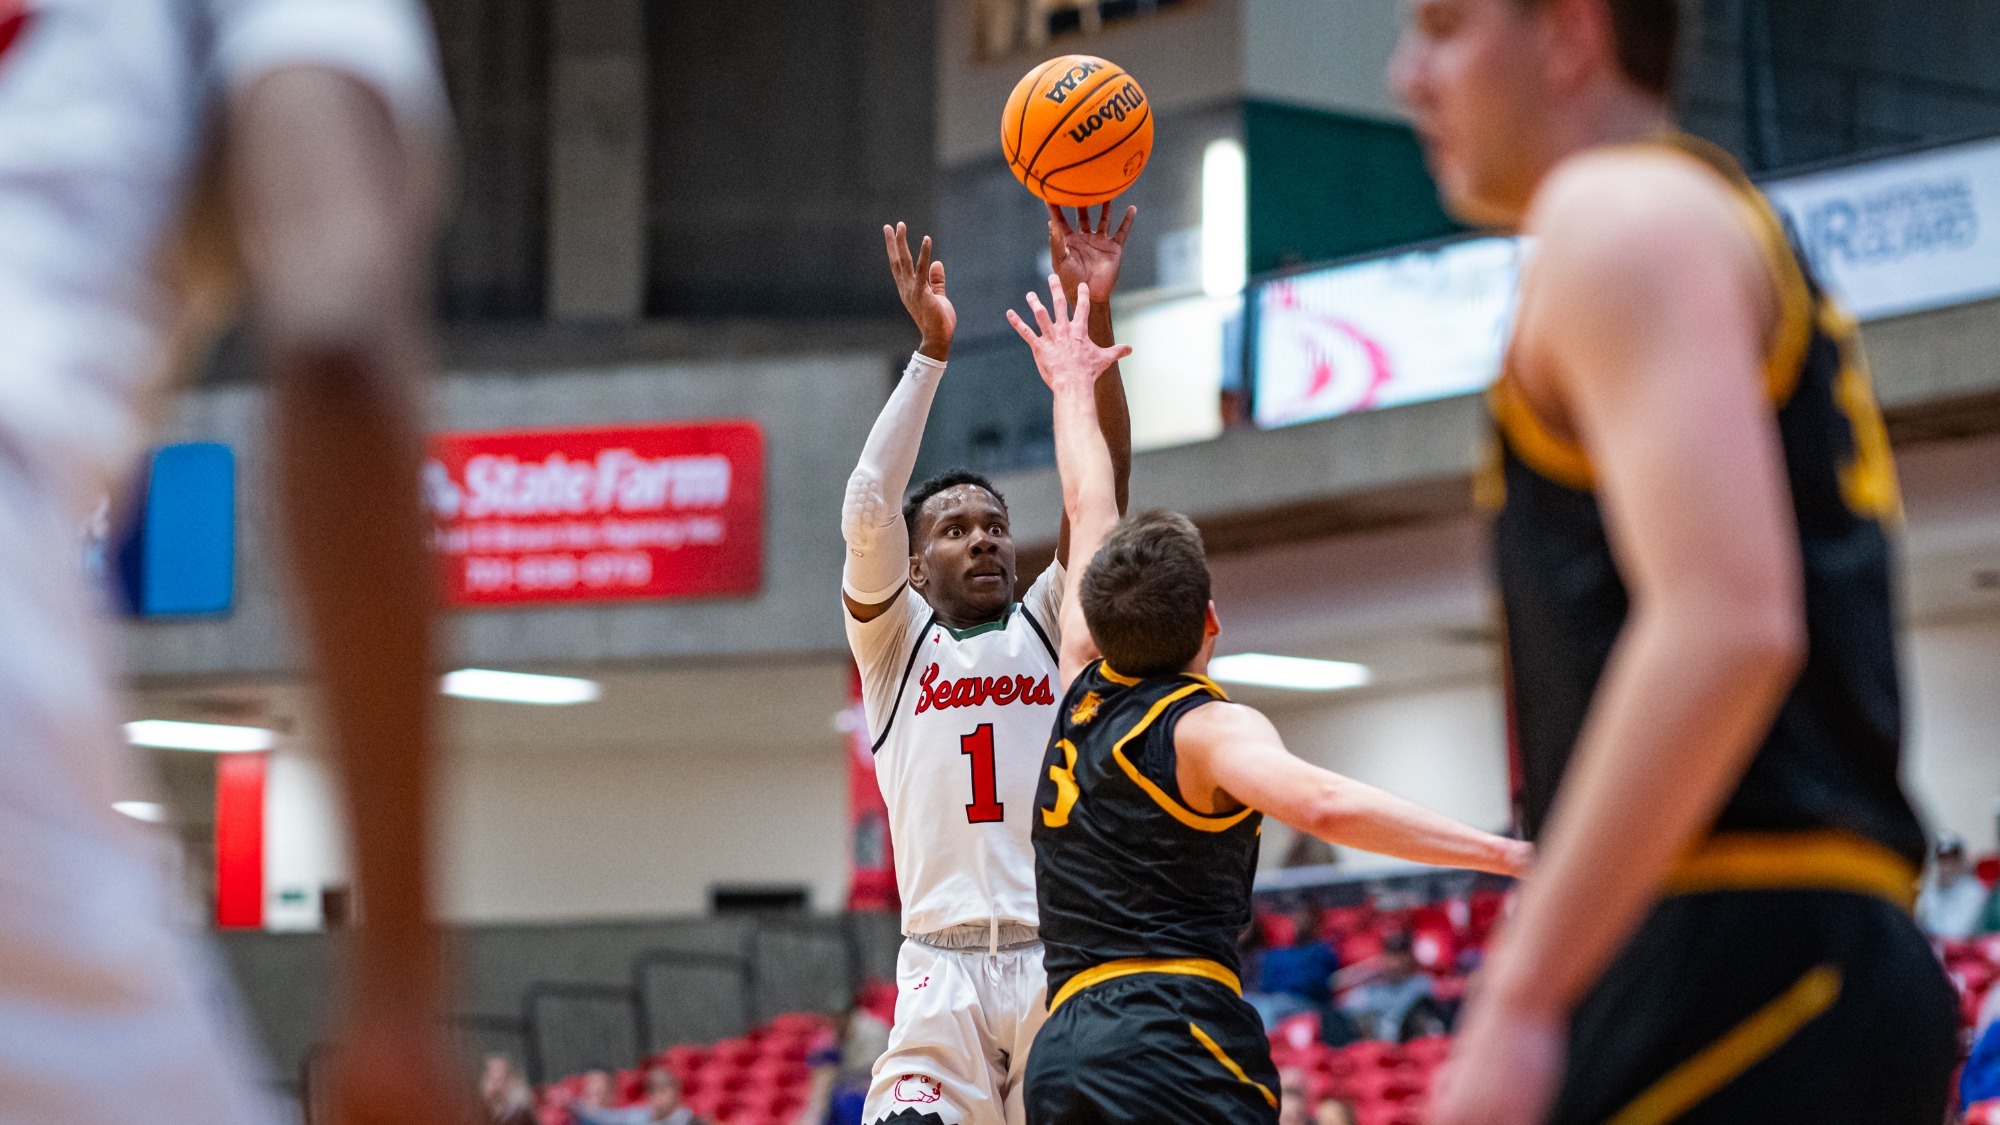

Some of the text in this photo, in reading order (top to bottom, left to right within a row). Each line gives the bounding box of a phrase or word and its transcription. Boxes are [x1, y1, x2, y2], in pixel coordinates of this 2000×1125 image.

[1045, 62, 1103, 104] NCAA
[1068, 82, 1144, 143] Wilson
[463, 448, 731, 518] State Farm
[915, 662, 1056, 716] Beavers
[960, 723, 1004, 824] 1
[1040, 738, 1081, 828] 3
